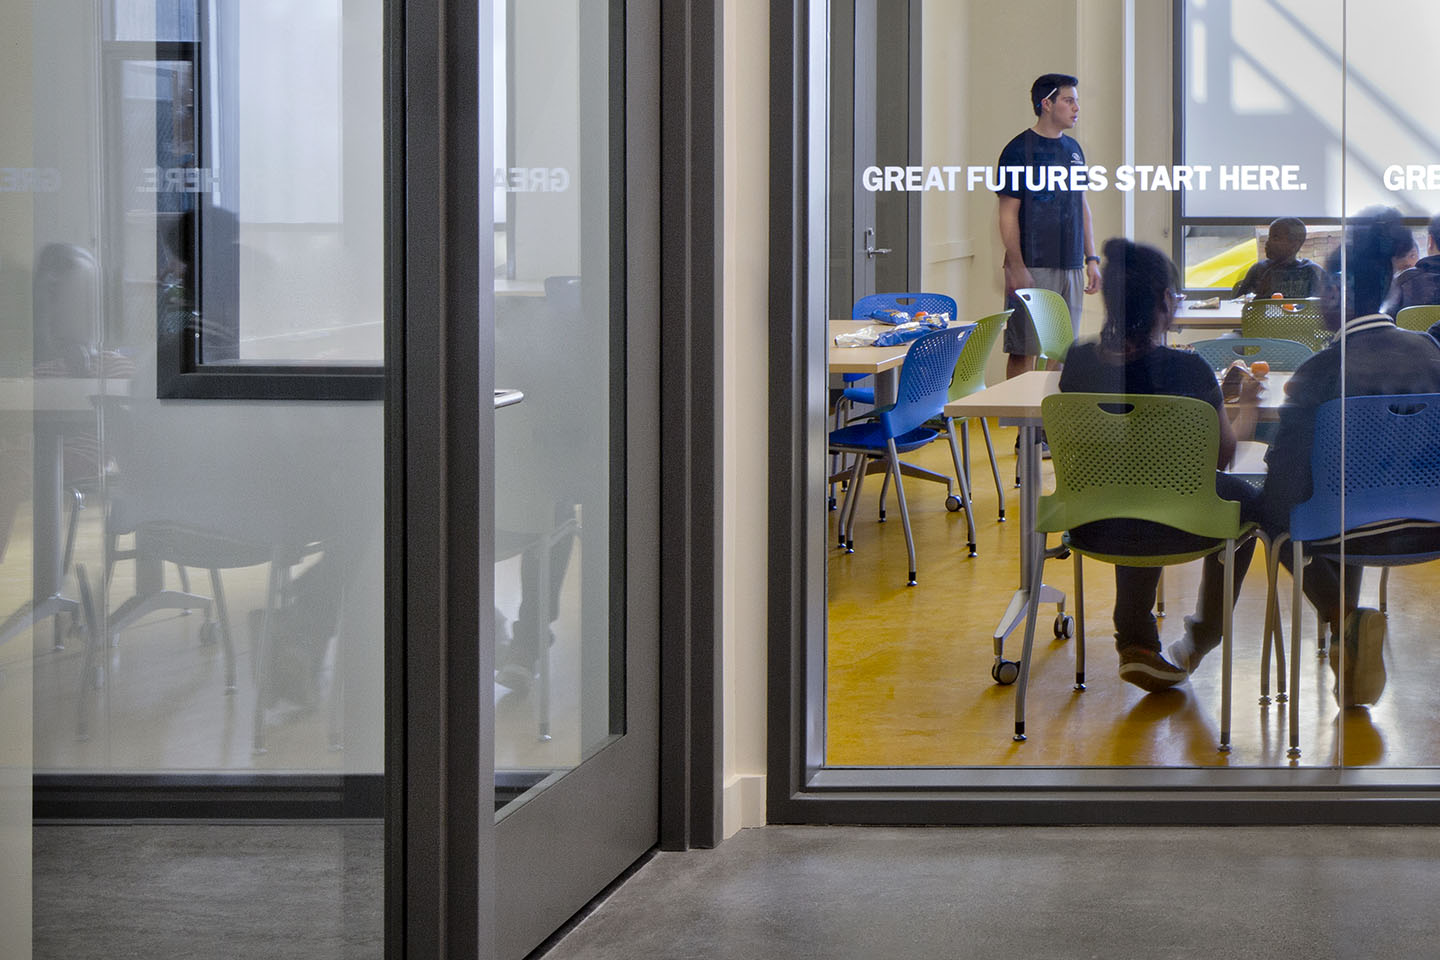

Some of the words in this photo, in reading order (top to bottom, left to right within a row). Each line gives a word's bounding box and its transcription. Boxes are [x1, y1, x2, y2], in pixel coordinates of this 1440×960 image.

[862, 165, 961, 192] GREAT
[967, 165, 1108, 192] FUTURES
[1115, 165, 1212, 192] START
[1219, 165, 1308, 192] HERE.
